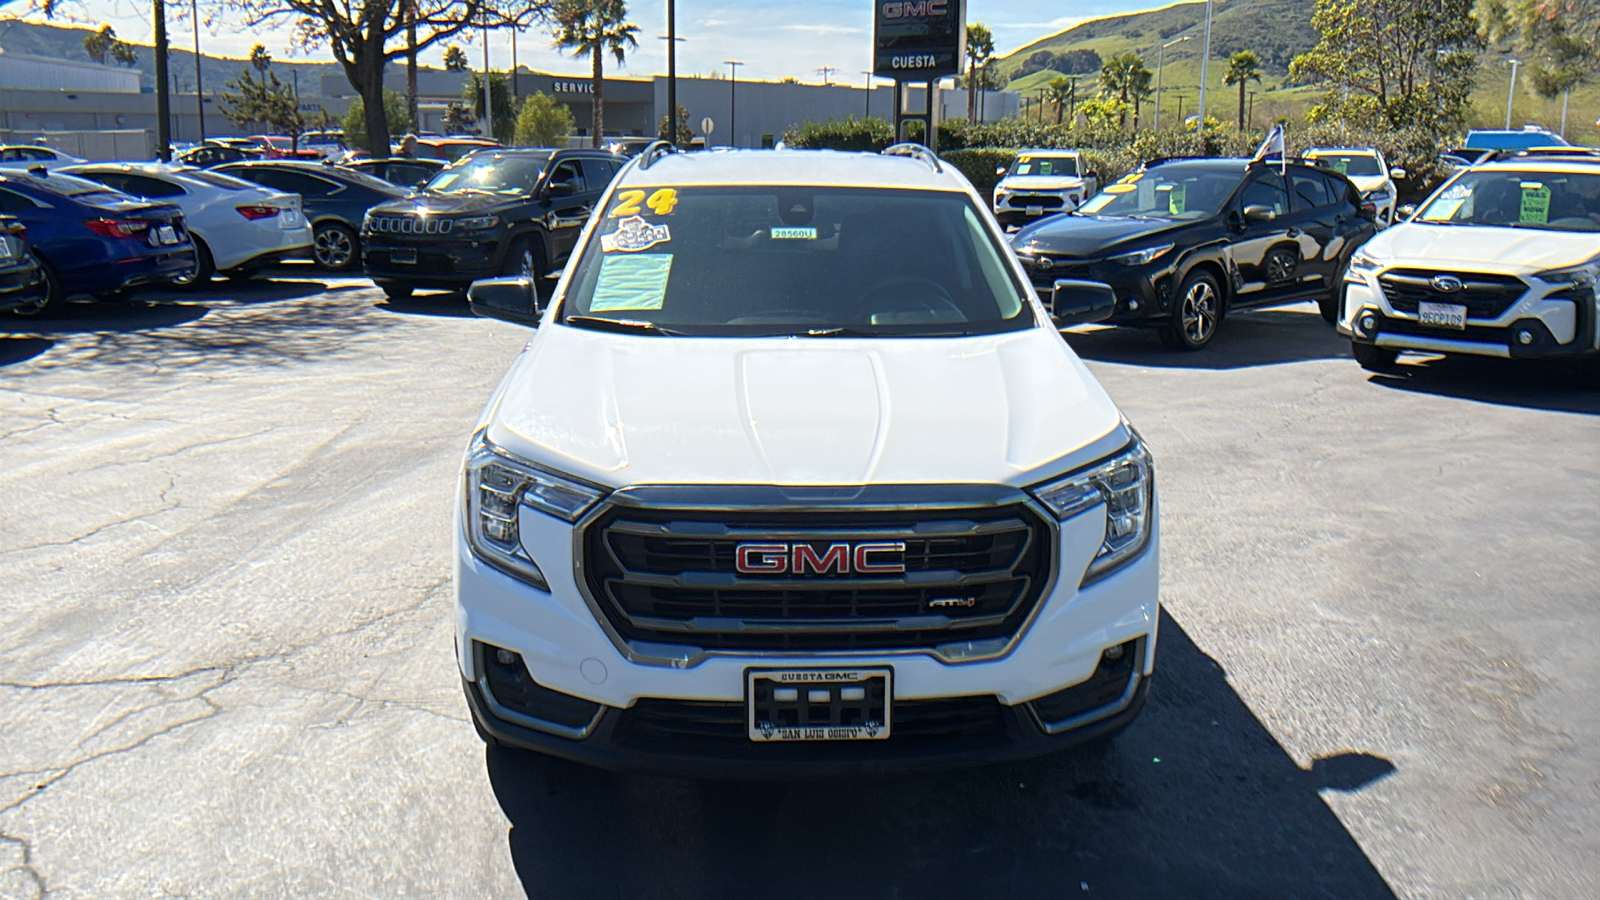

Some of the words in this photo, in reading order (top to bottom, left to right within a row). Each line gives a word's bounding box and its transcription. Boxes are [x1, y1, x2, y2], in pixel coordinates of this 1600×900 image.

[883, 0, 947, 18] GMC
[892, 55, 936, 69] CUESTA
[611, 188, 678, 216] 24
[735, 542, 906, 573] GMC
[781, 673, 823, 681] CUESTA
[824, 672, 859, 680] GMC
[781, 729, 801, 739] SAN
[804, 729, 825, 739] LUIS
[827, 728, 858, 738] OBISPO
